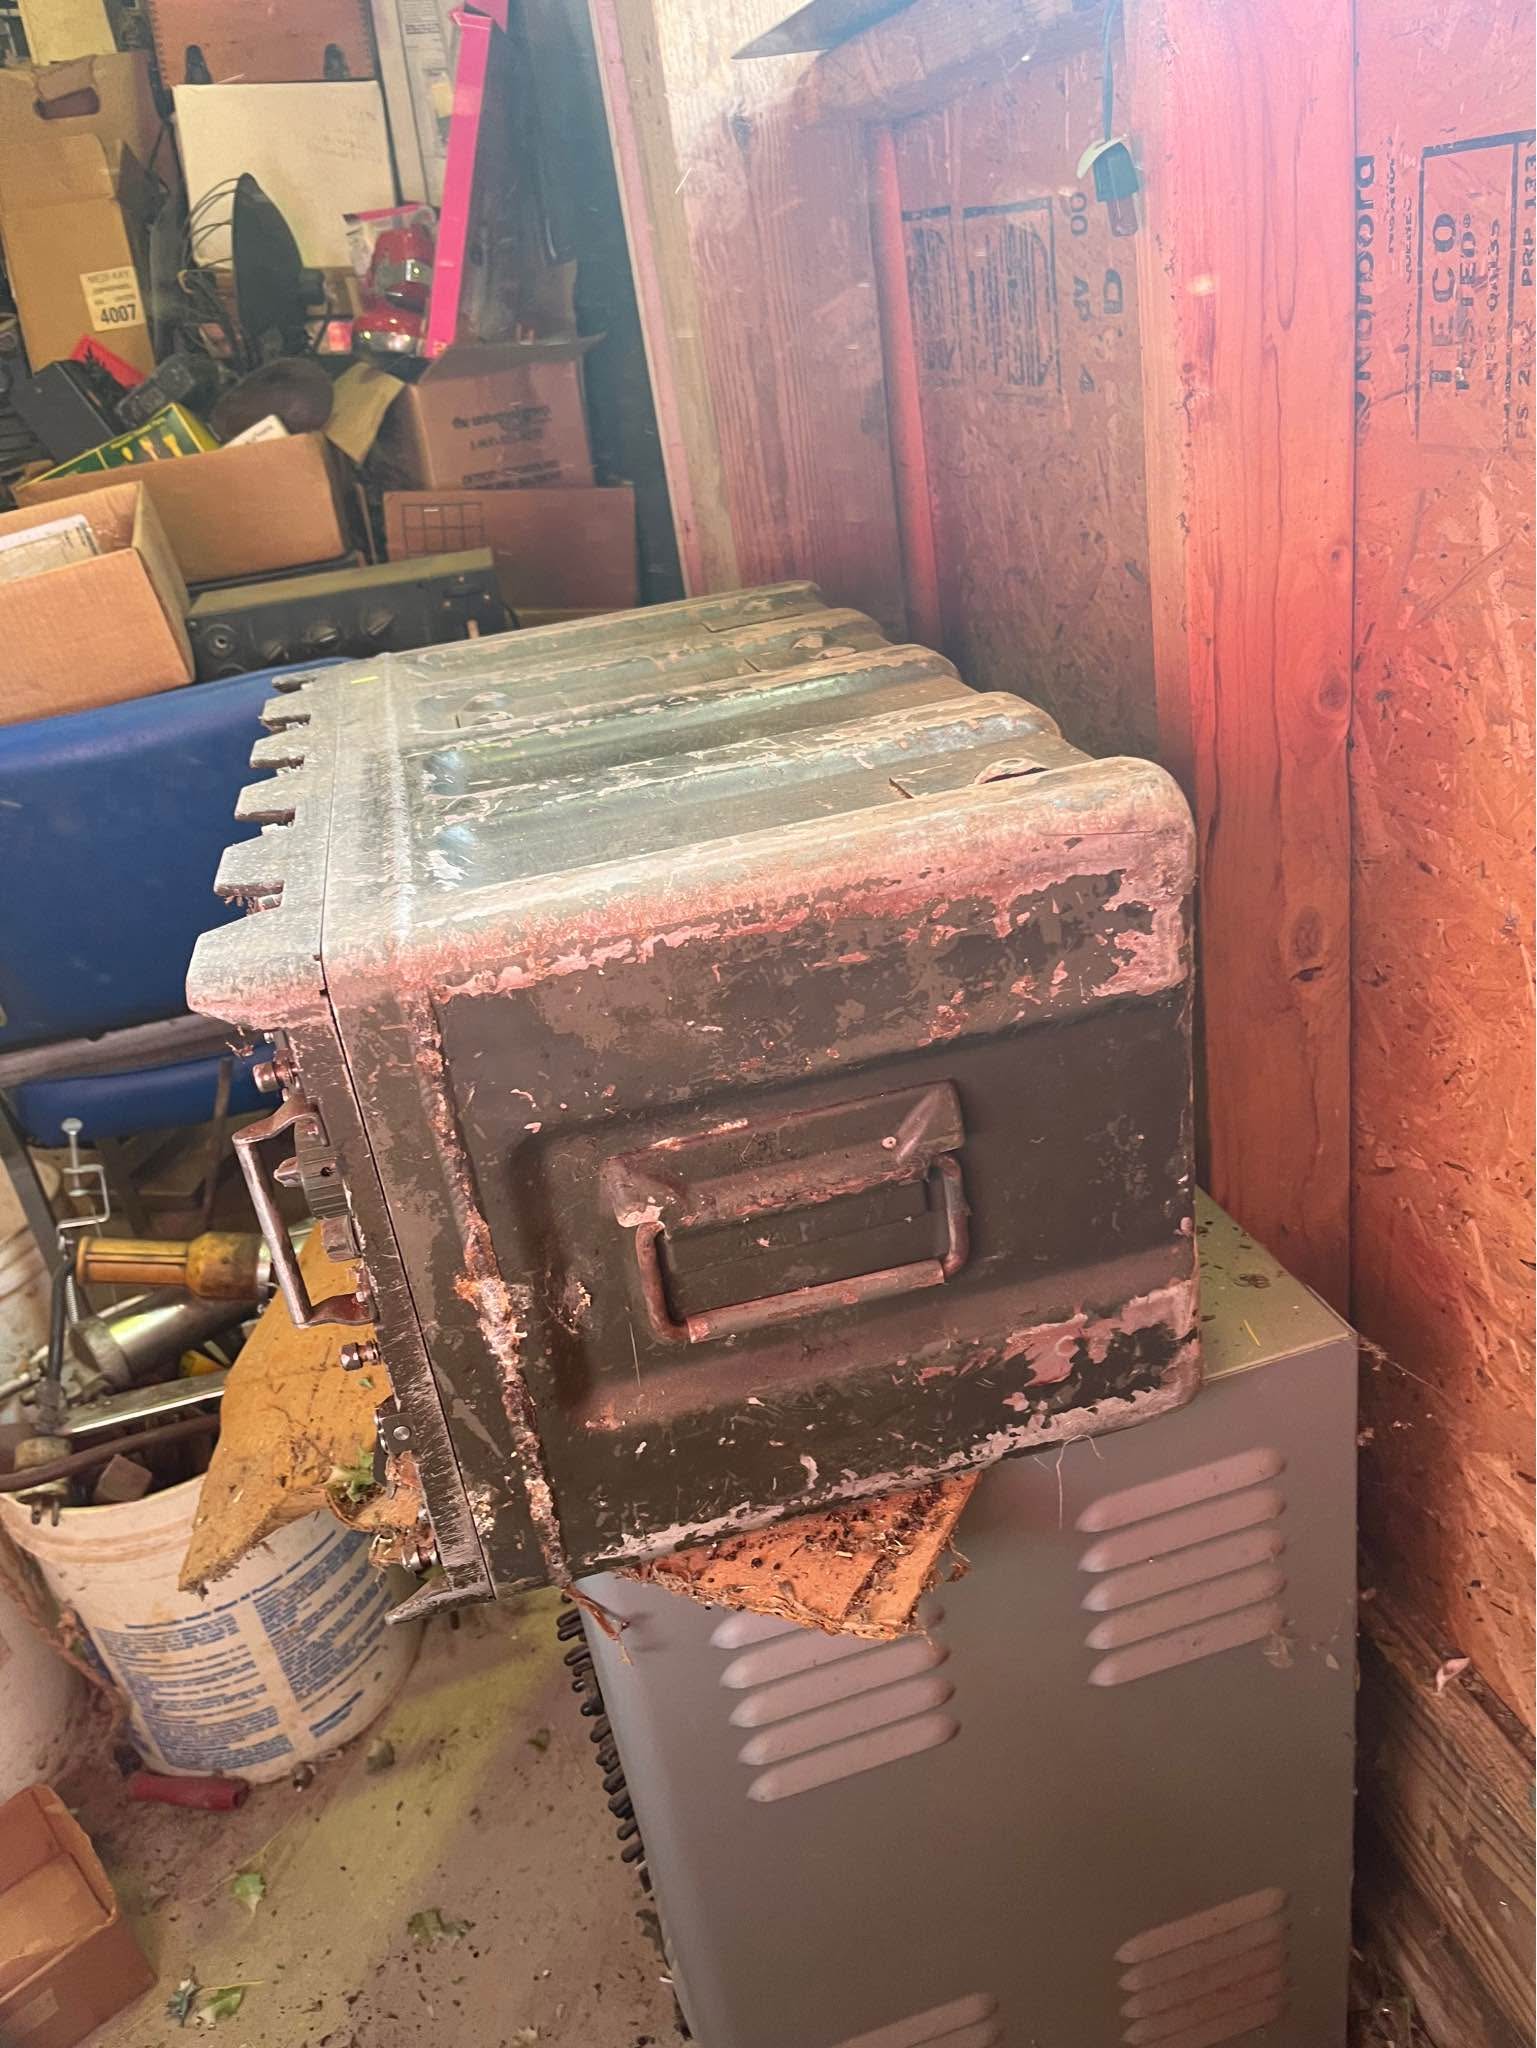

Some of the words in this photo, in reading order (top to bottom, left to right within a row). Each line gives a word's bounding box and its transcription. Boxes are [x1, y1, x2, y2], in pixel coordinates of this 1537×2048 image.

[1521, 227, 1536, 287] PRP
[100, 303, 135, 324] 4007
[1429, 213, 1457, 392] TECO
